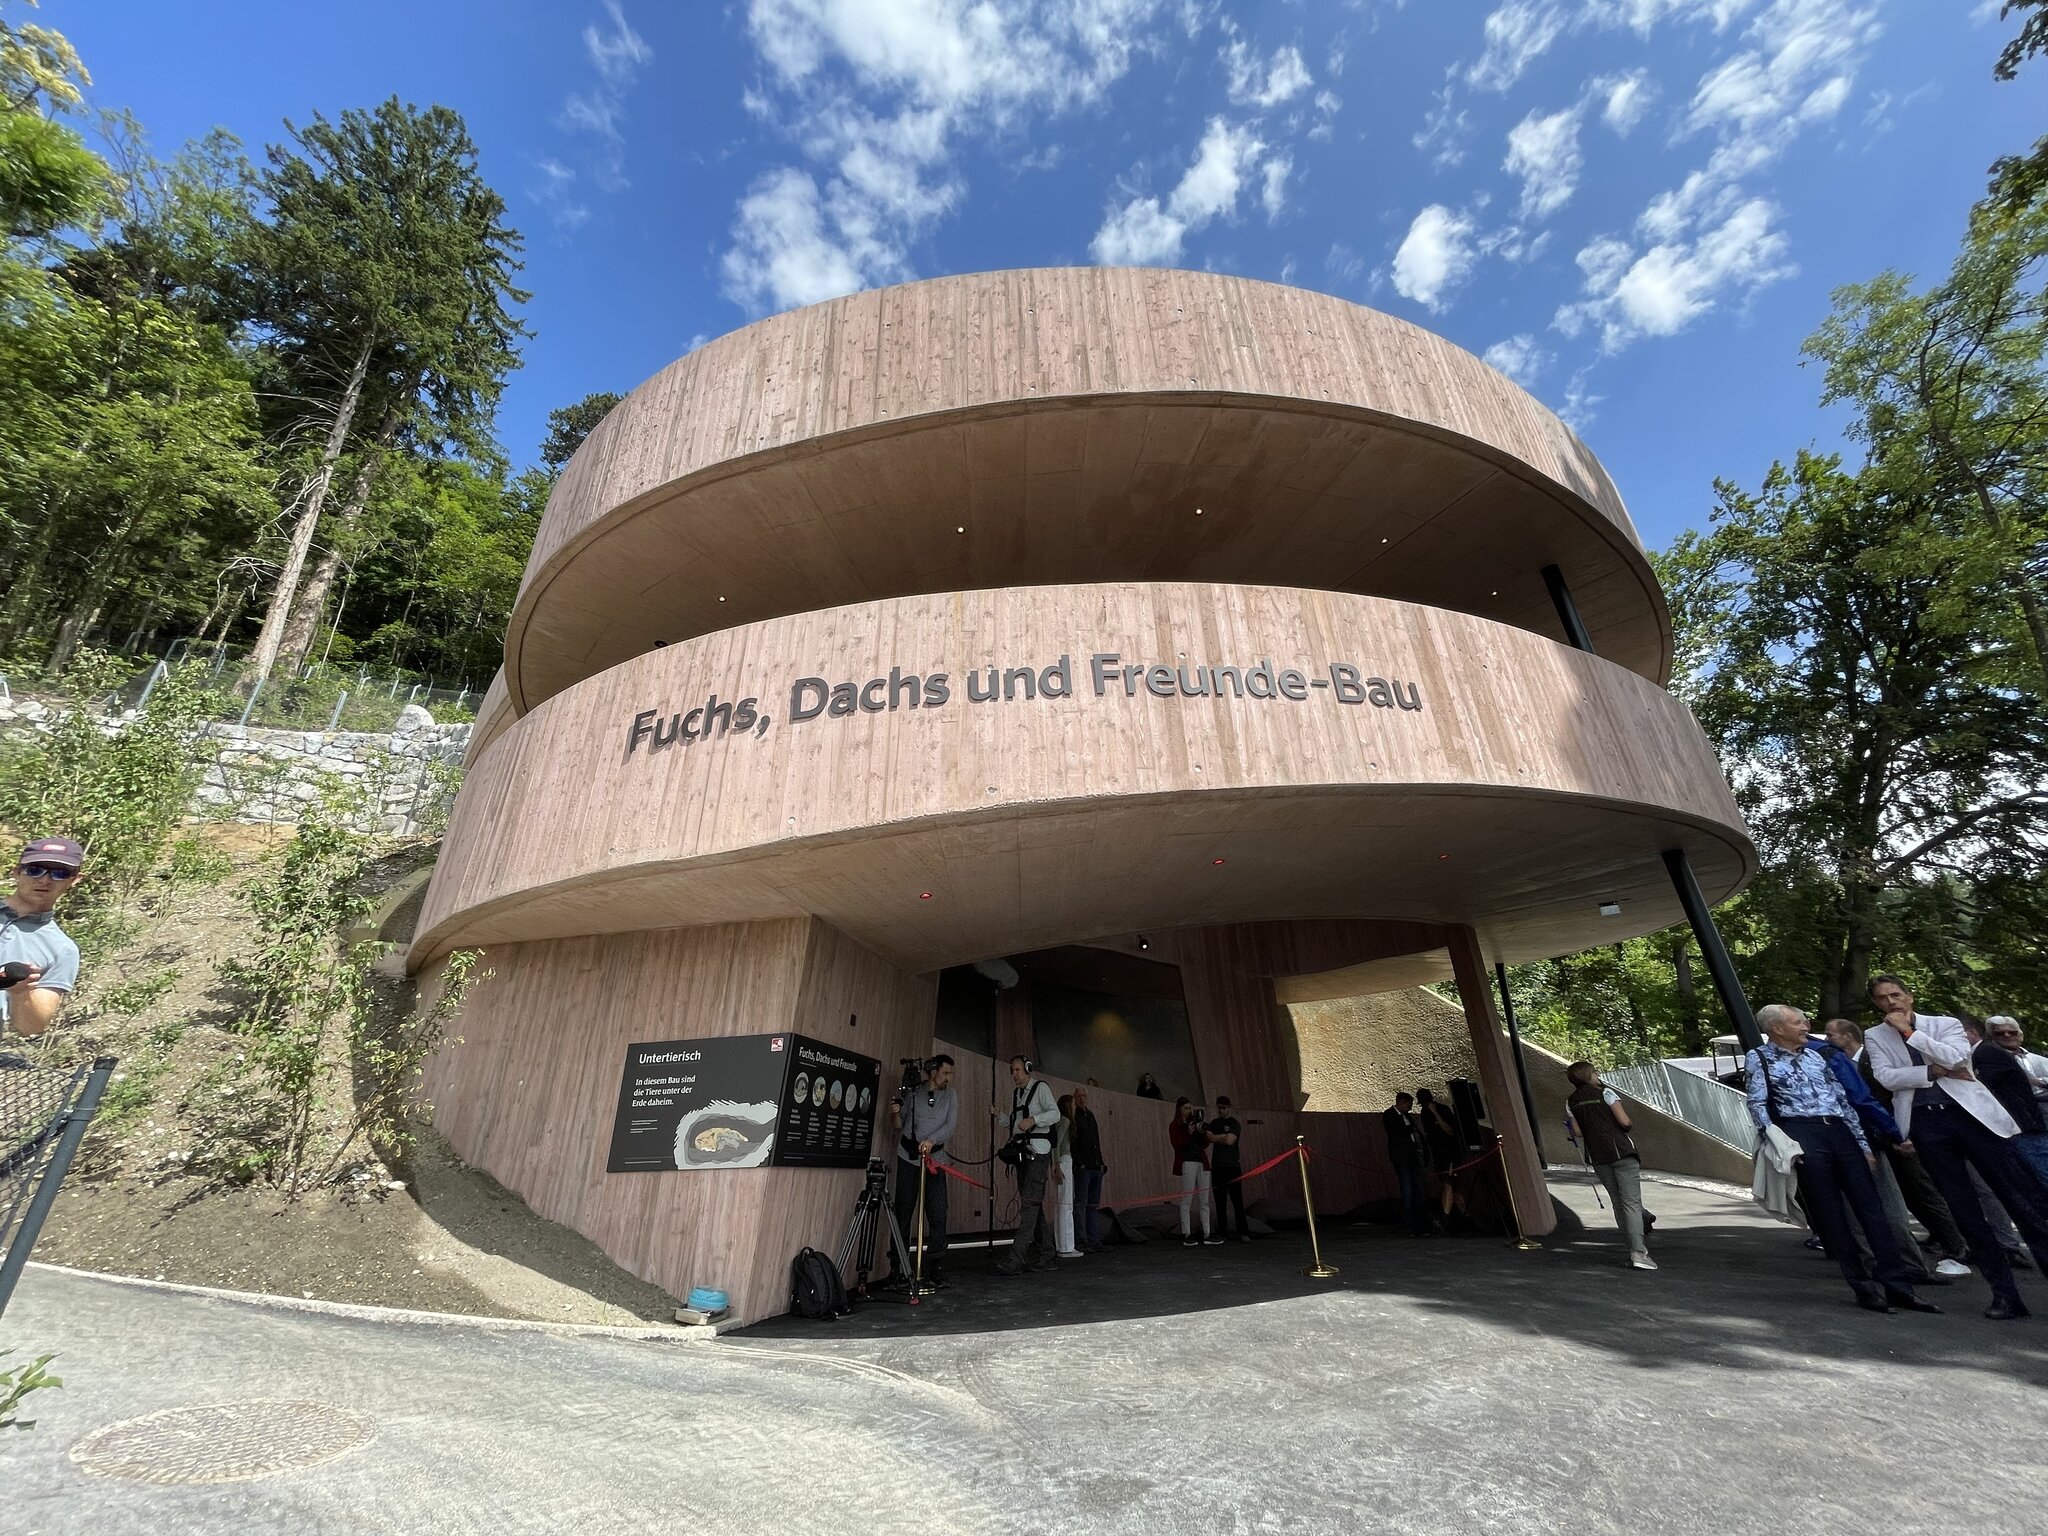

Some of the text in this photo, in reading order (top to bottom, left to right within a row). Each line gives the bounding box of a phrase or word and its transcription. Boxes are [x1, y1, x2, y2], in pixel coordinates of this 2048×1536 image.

[629, 652, 1424, 753] Fuchs, Dachs und Freunde-Bau
[639, 1050, 701, 1064] Untertierisch
[799, 1046, 857, 1072] Fuchs, Dachs und Freunde
[643, 1077, 667, 1085] diesem
[668, 1076, 680, 1084] Bau
[681, 1075, 696, 1083] sind
[645, 1088, 661, 1096] Tiere
[680, 1086, 693, 1094] der
[632, 1098, 674, 1107] Erde daheim.
